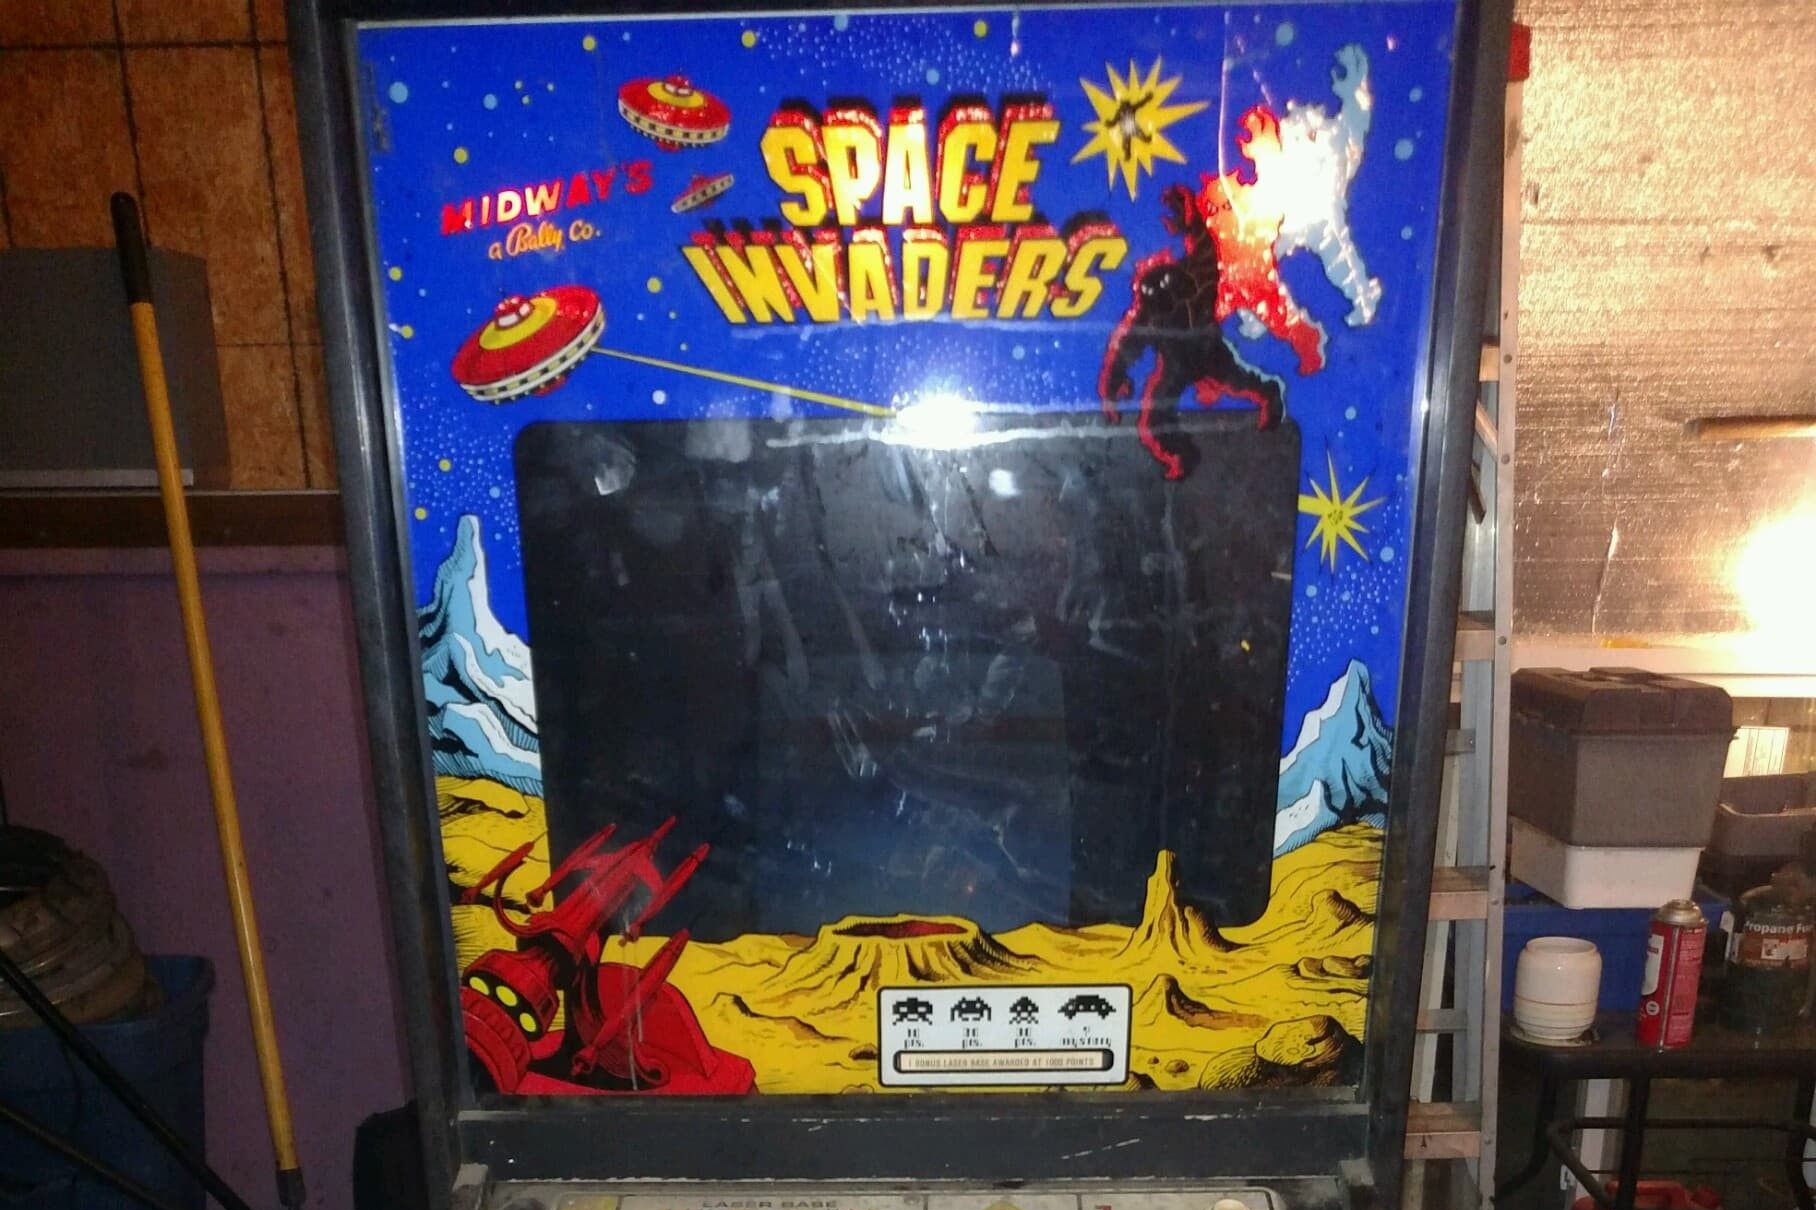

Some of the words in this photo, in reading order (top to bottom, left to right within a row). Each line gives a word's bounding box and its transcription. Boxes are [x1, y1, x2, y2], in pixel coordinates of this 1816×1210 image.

[441, 160, 653, 236] MIDWAY'S
[760, 97, 1061, 227] SPACE
[506, 221, 565, 257] Bally
[682, 215, 1128, 325] INVADERS
